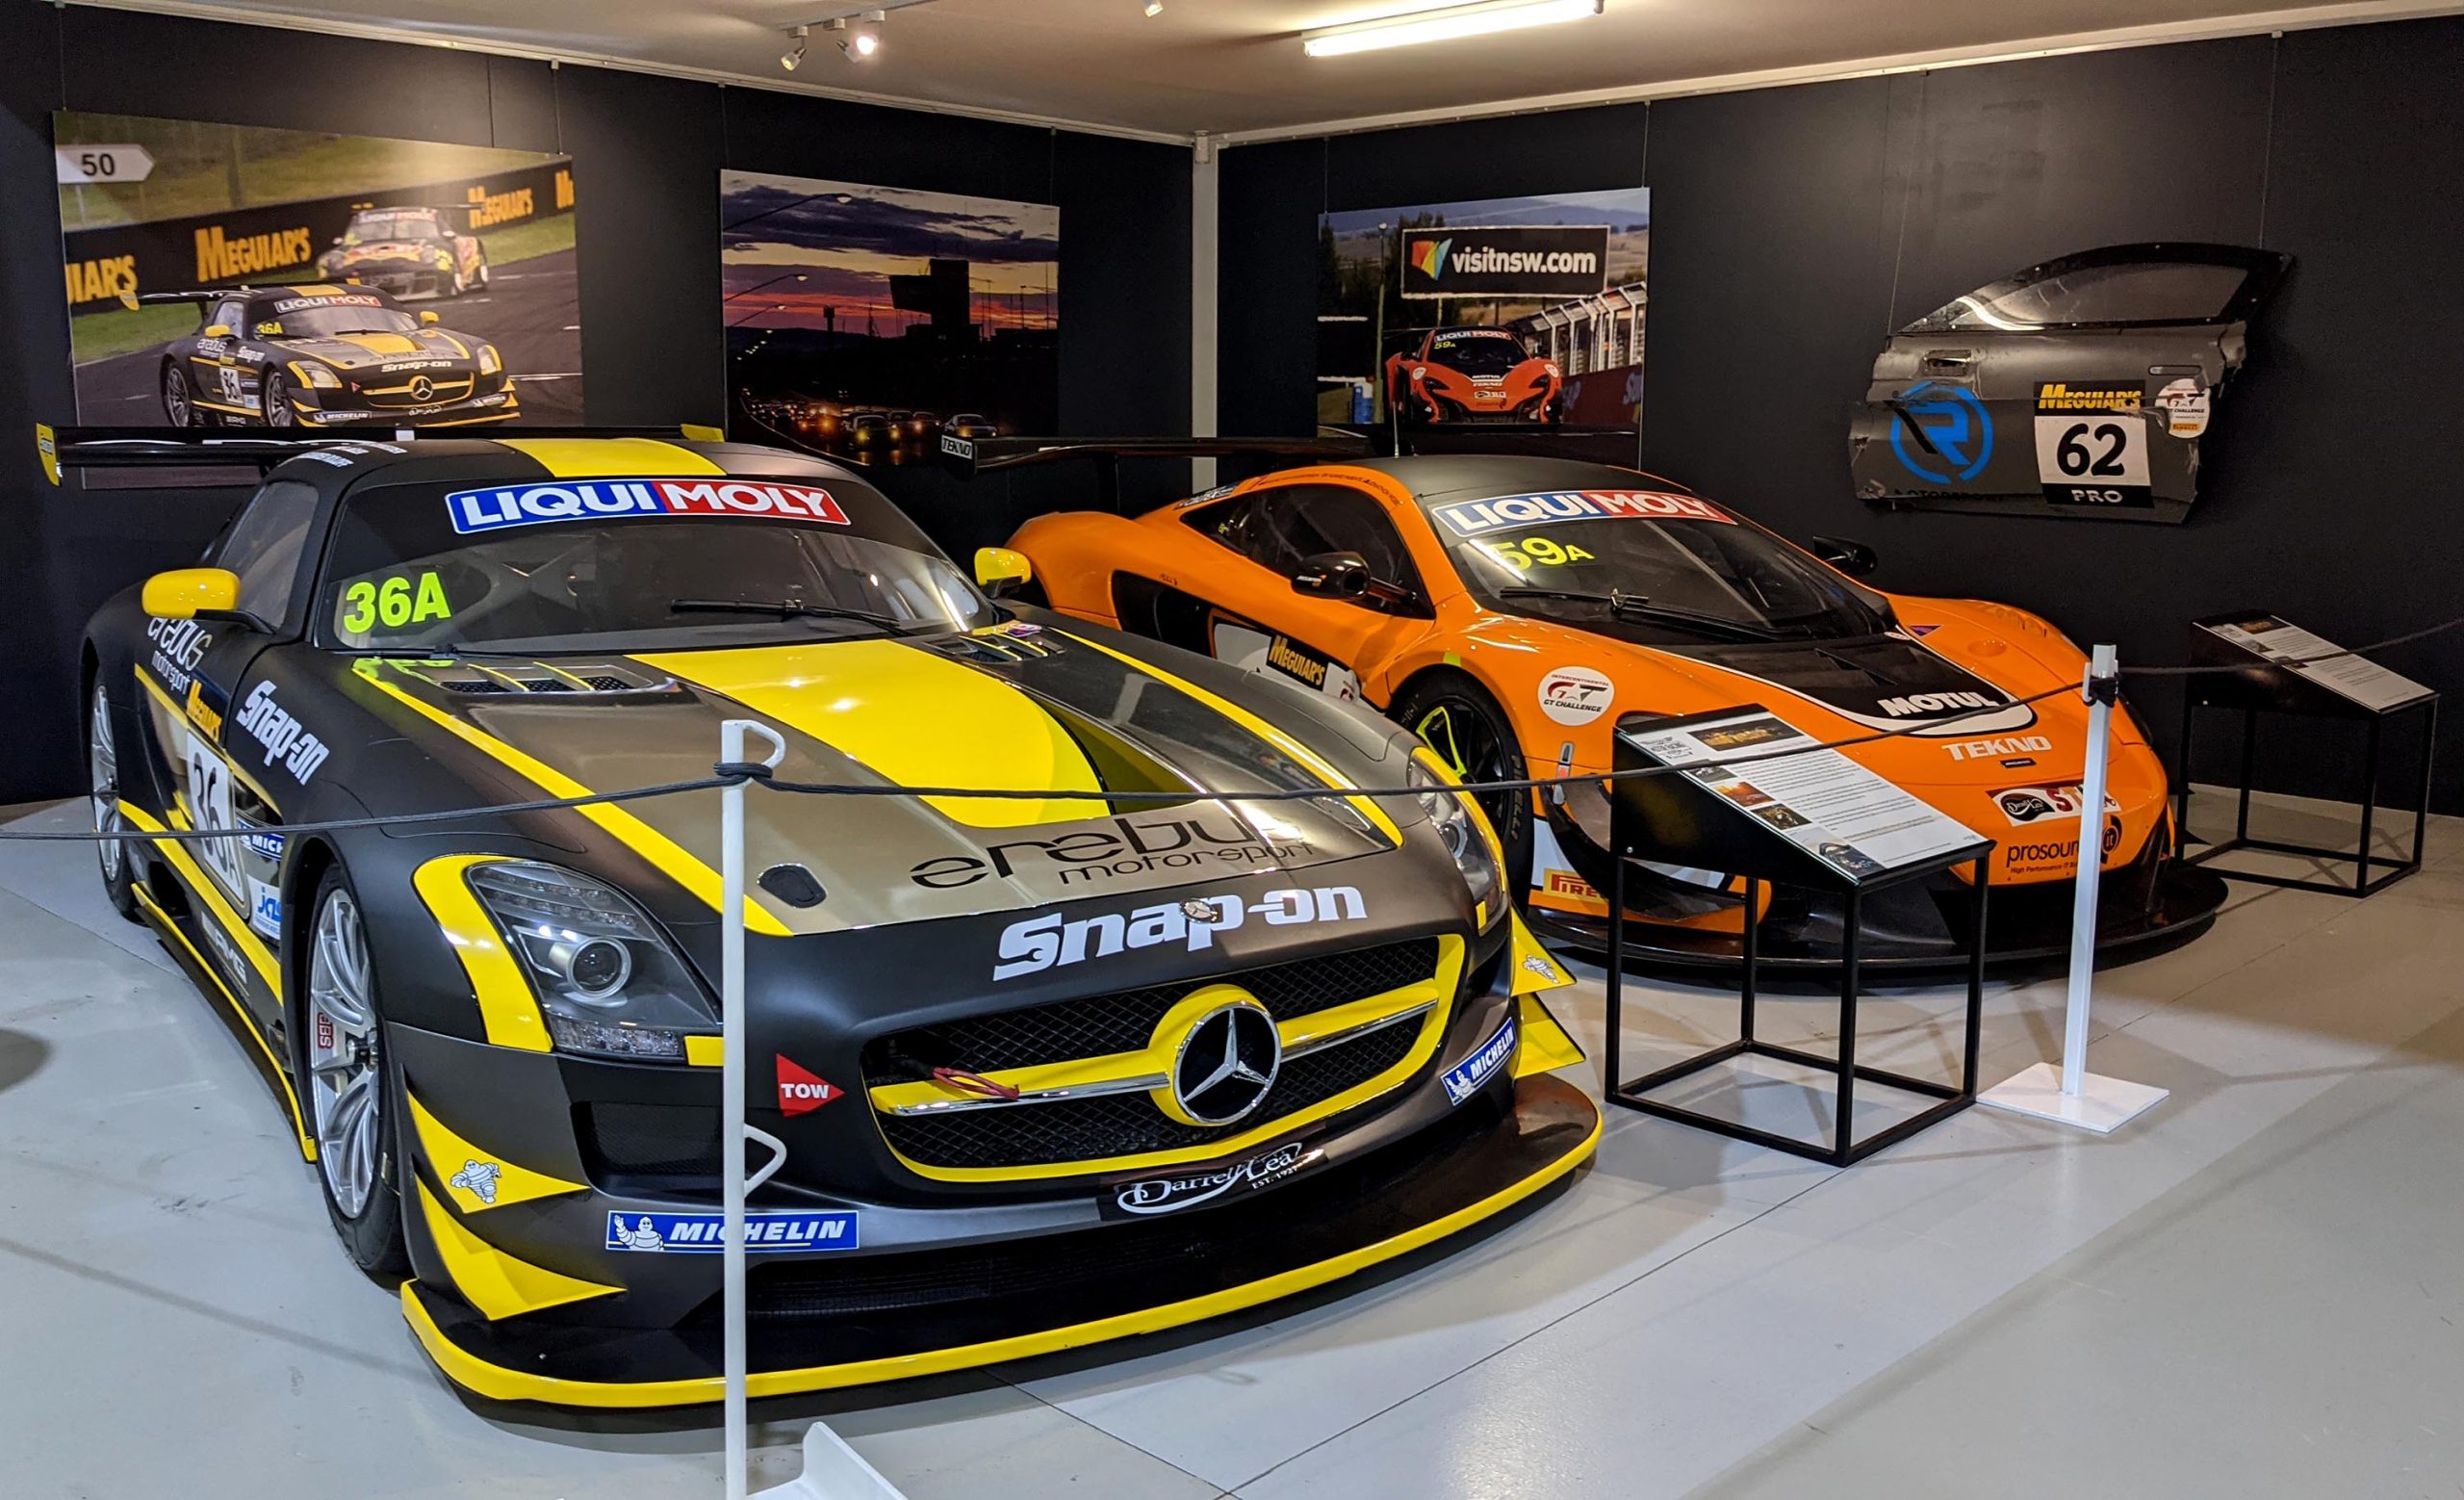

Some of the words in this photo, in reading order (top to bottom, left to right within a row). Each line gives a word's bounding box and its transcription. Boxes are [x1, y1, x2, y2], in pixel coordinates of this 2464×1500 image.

[81, 154, 116, 176] 50
[195, 225, 311, 282] MEGUIAR'S
[1452, 246, 1597, 274] visitnsw.com
[278, 297, 328, 312] LIQUI
[327, 295, 376, 306] MOLY
[381, 360, 452, 374] Snap-on
[2057, 423, 2127, 476] 62
[461, 483, 660, 524] LIQUI
[659, 482, 831, 518] MOLY
[1445, 494, 1601, 529] LIQUI
[1589, 493, 1720, 518] MOLY
[2071, 488, 2123, 504] PRO
[1491, 536, 1595, 572] 59A
[344, 572, 451, 634] 36A
[152, 650, 192, 695] motorsport
[1269, 634, 1325, 685] MEGUIAR'S
[1555, 700, 1603, 712] CHALLENGE
[1878, 691, 2000, 716] MOTUL
[236, 680, 329, 786] Snap-on
[1940, 736, 2052, 761] TEKNO
[252, 834, 283, 854] MICH
[2006, 841, 2079, 867] prosour
[1059, 842, 1314, 885] motorsport
[1552, 873, 1600, 897] PIRE
[992, 885, 1369, 982] Snap-on
[1470, 1025, 1514, 1080] MICHELIN
[780, 1081, 831, 1099] TOW
[1117, 1162, 1247, 1214] Darrell
[1242, 1142, 1302, 1182] Lea
[1251, 1176, 1275, 1190] EST.
